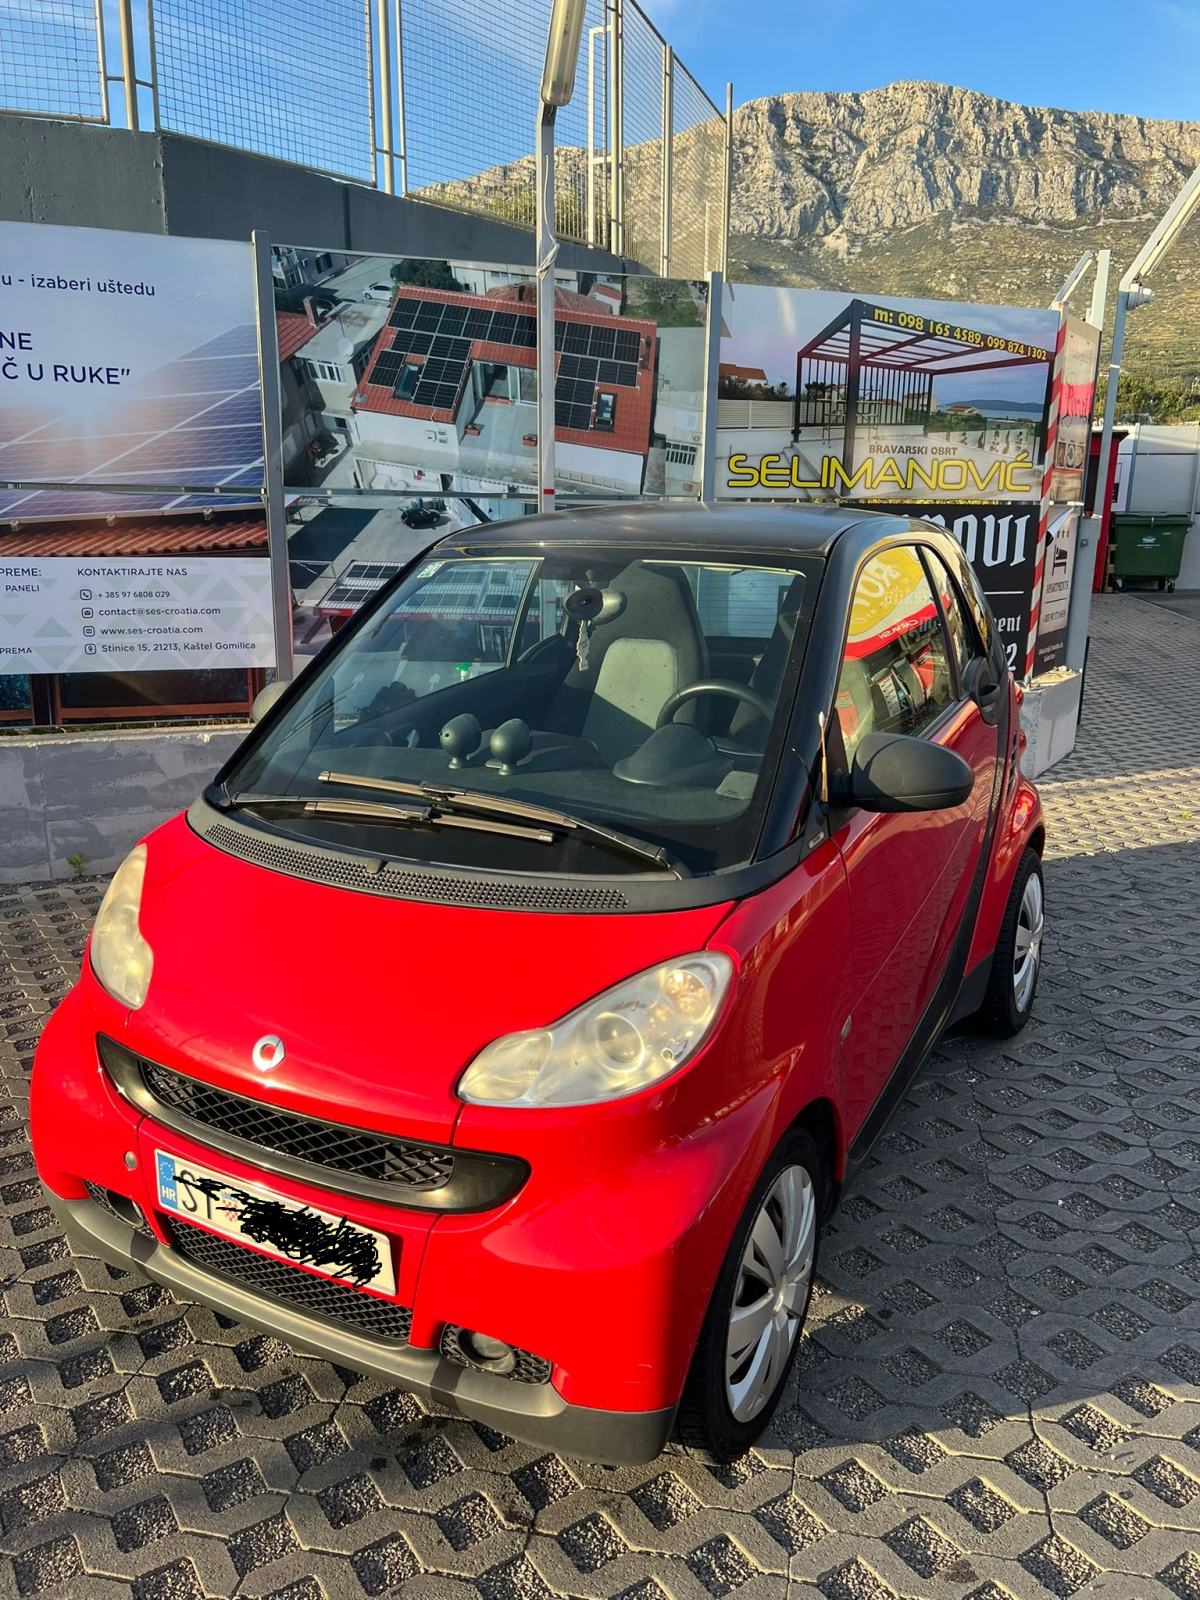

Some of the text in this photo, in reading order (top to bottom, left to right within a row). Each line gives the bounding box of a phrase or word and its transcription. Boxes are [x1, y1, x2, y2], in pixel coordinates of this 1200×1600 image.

[31, 274, 91, 292] izaberi
[97, 279, 156, 297] uštedu
[0, 331, 33, 351] NE
[873, 308, 1047, 361] m: 098 165 4589, 099 874 1302
[2, 356, 19, 380] Č
[27, 363, 44, 381] U
[868, 444, 958, 456] BRAVARSKI OBRT
[727, 450, 1034, 493] SELIMANOVIĆ
[77, 568, 188, 577] KONTAKTIRAJTE NAS
[5, 584, 40, 592] PANELI
[105, 591, 120, 599] 385
[133, 591, 153, 599] 6808
[98, 607, 222, 616] contact@ses-croatia.com
[100, 626, 203, 635] www.ses-croatia.com
[994, 614, 1022, 633] ent
[102, 644, 135, 653] Stinice
[153, 643, 181, 652] 21213,
[183, 642, 213, 651] Kaštel
[215, 641, 256, 651] Gomilica
[161, 1185, 177, 1202] HR
